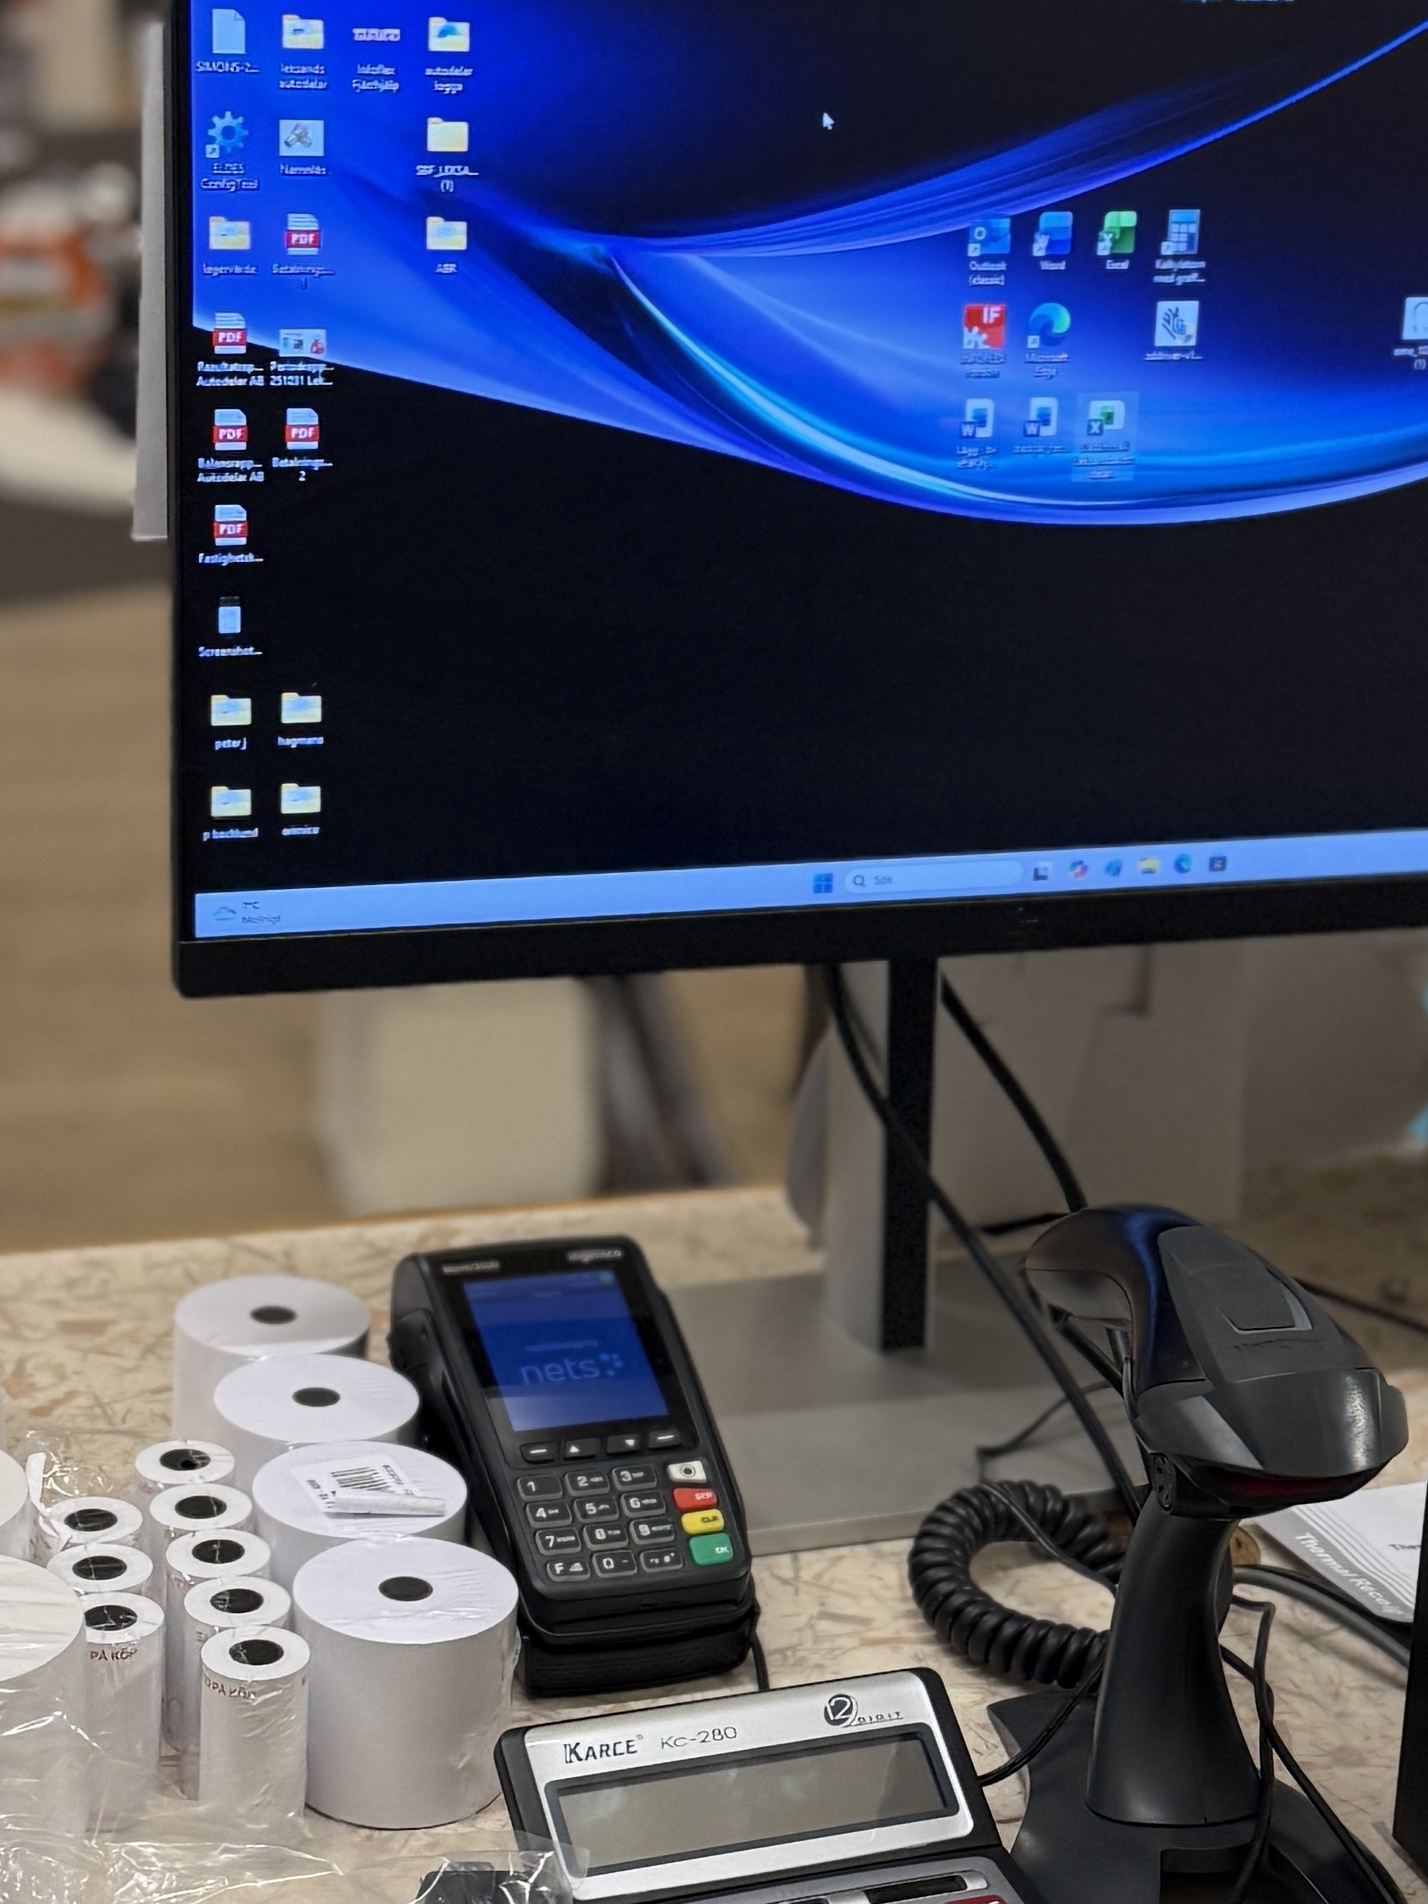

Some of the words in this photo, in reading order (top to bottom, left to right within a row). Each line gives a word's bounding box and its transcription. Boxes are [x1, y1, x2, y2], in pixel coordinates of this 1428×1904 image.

[969, 261, 1007, 271] Outlook
[1040, 260, 1066, 271] Word
[1105, 259, 1130, 270] Excel
[982, 307, 1001, 324] IF
[218, 332, 243, 343] PDF
[218, 428, 243, 440] PDF
[290, 427, 316, 439] PDF
[298, 471, 307, 482] 2
[520, 1357, 601, 1385] nets
[563, 1737, 638, 1765] KARCE
